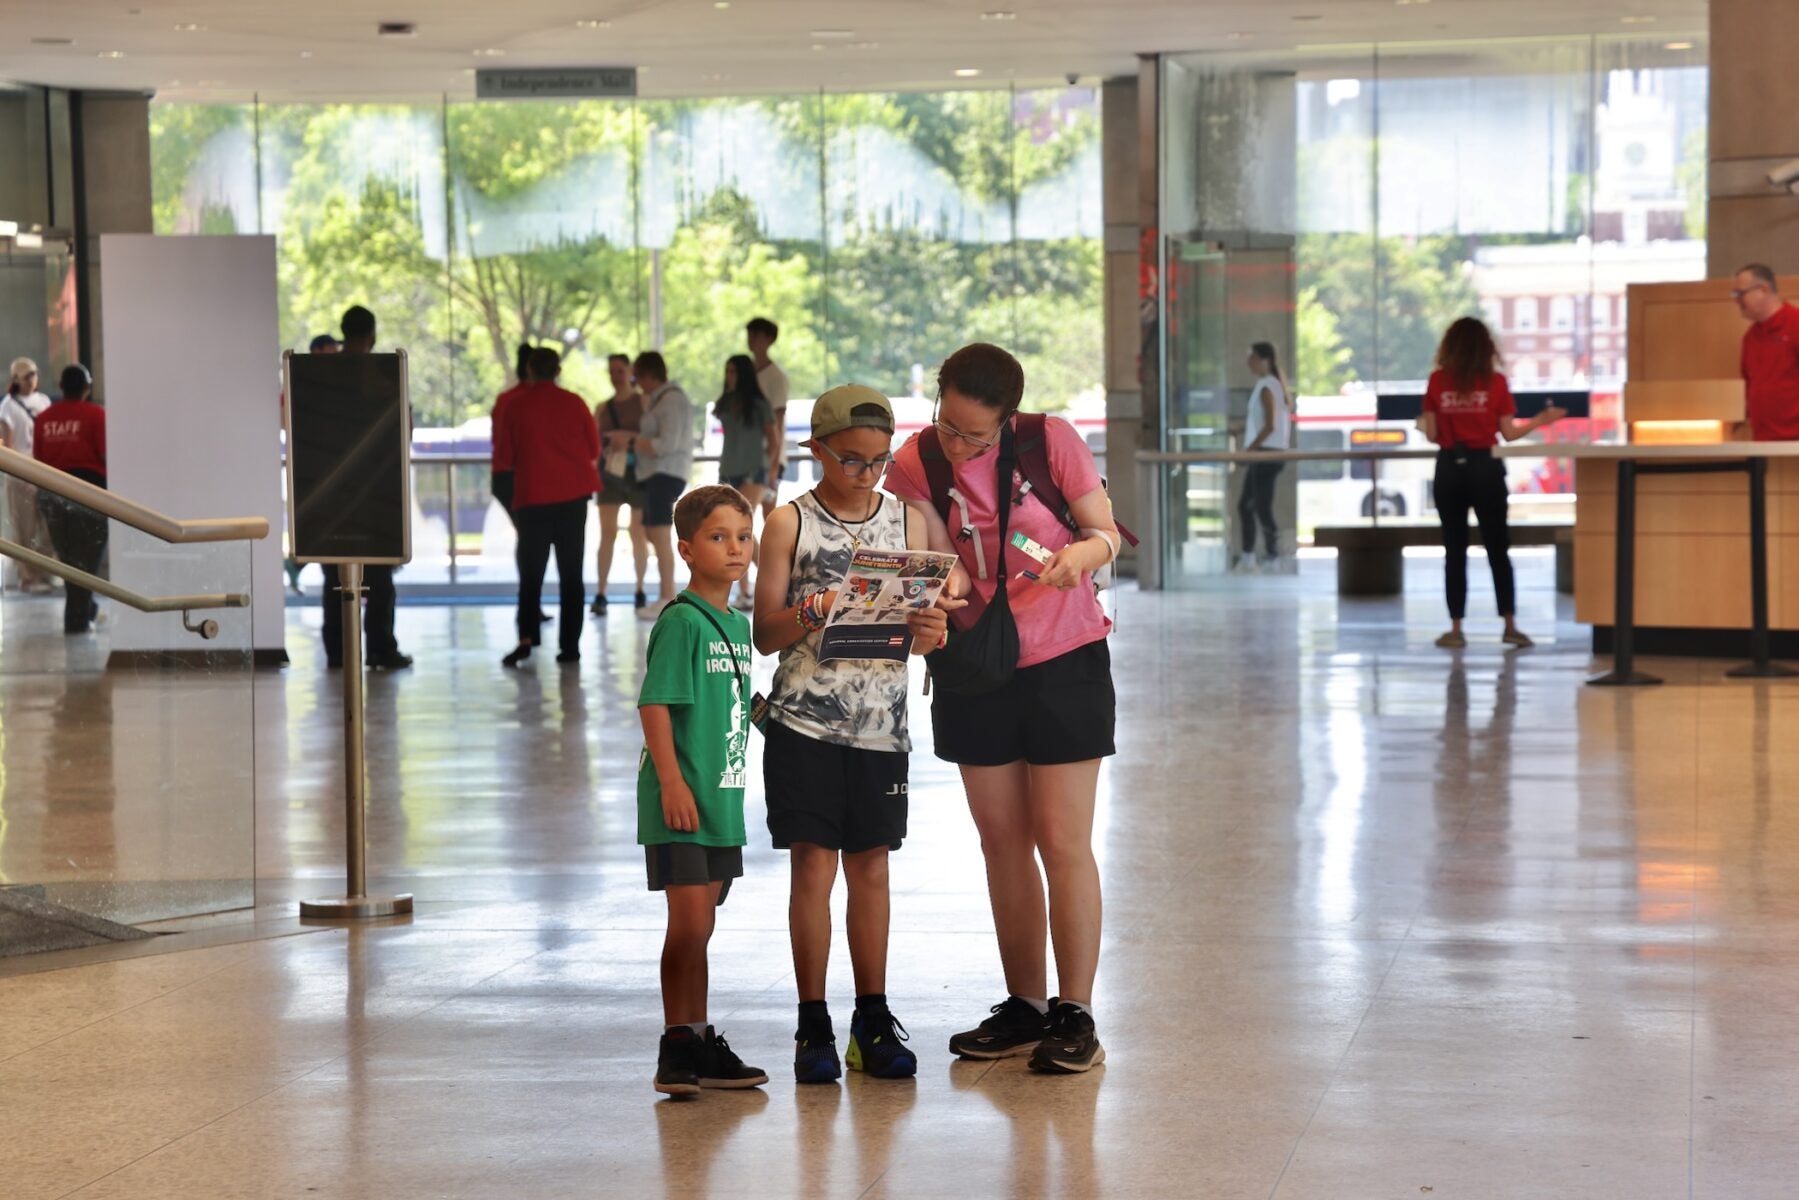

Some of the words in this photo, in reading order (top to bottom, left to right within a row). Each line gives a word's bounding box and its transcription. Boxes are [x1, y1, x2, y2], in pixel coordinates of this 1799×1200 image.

[501, 75, 594, 92] Independence
[600, 74, 630, 88] Mall
[43, 419, 81, 437] STAFF
[859, 555, 899, 563] CELEBRATE
[709, 641, 741, 656] NORH
